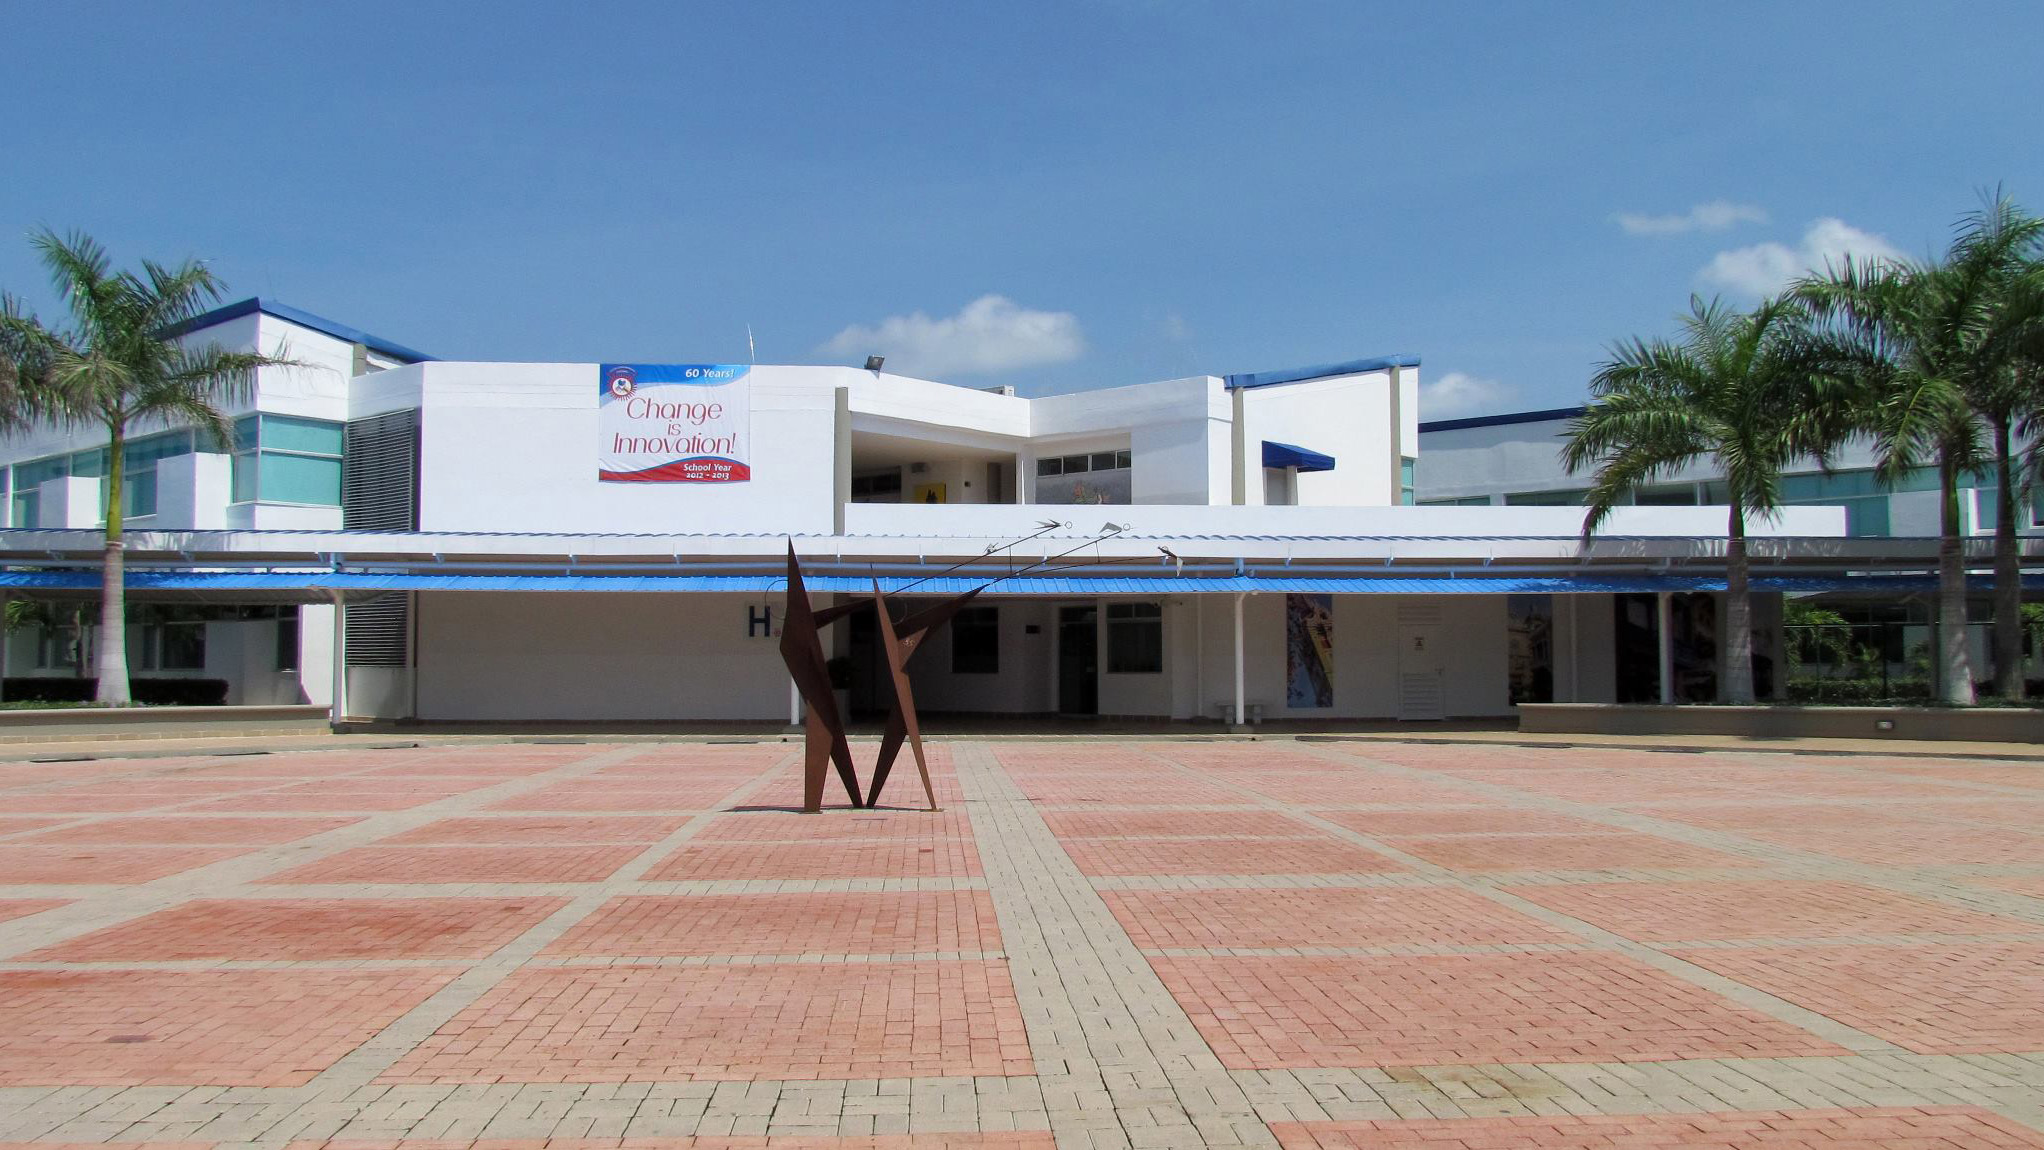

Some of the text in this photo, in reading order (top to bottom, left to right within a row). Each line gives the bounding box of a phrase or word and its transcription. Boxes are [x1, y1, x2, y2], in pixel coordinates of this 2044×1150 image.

[685, 368, 735, 378] 60 Years!
[627, 397, 723, 426] Change
[667, 420, 681, 436] is
[613, 432, 737, 454] Innovation!
[683, 463, 732, 471] School Year
[712, 472, 730, 480] 2013
[749, 605, 770, 637] H
